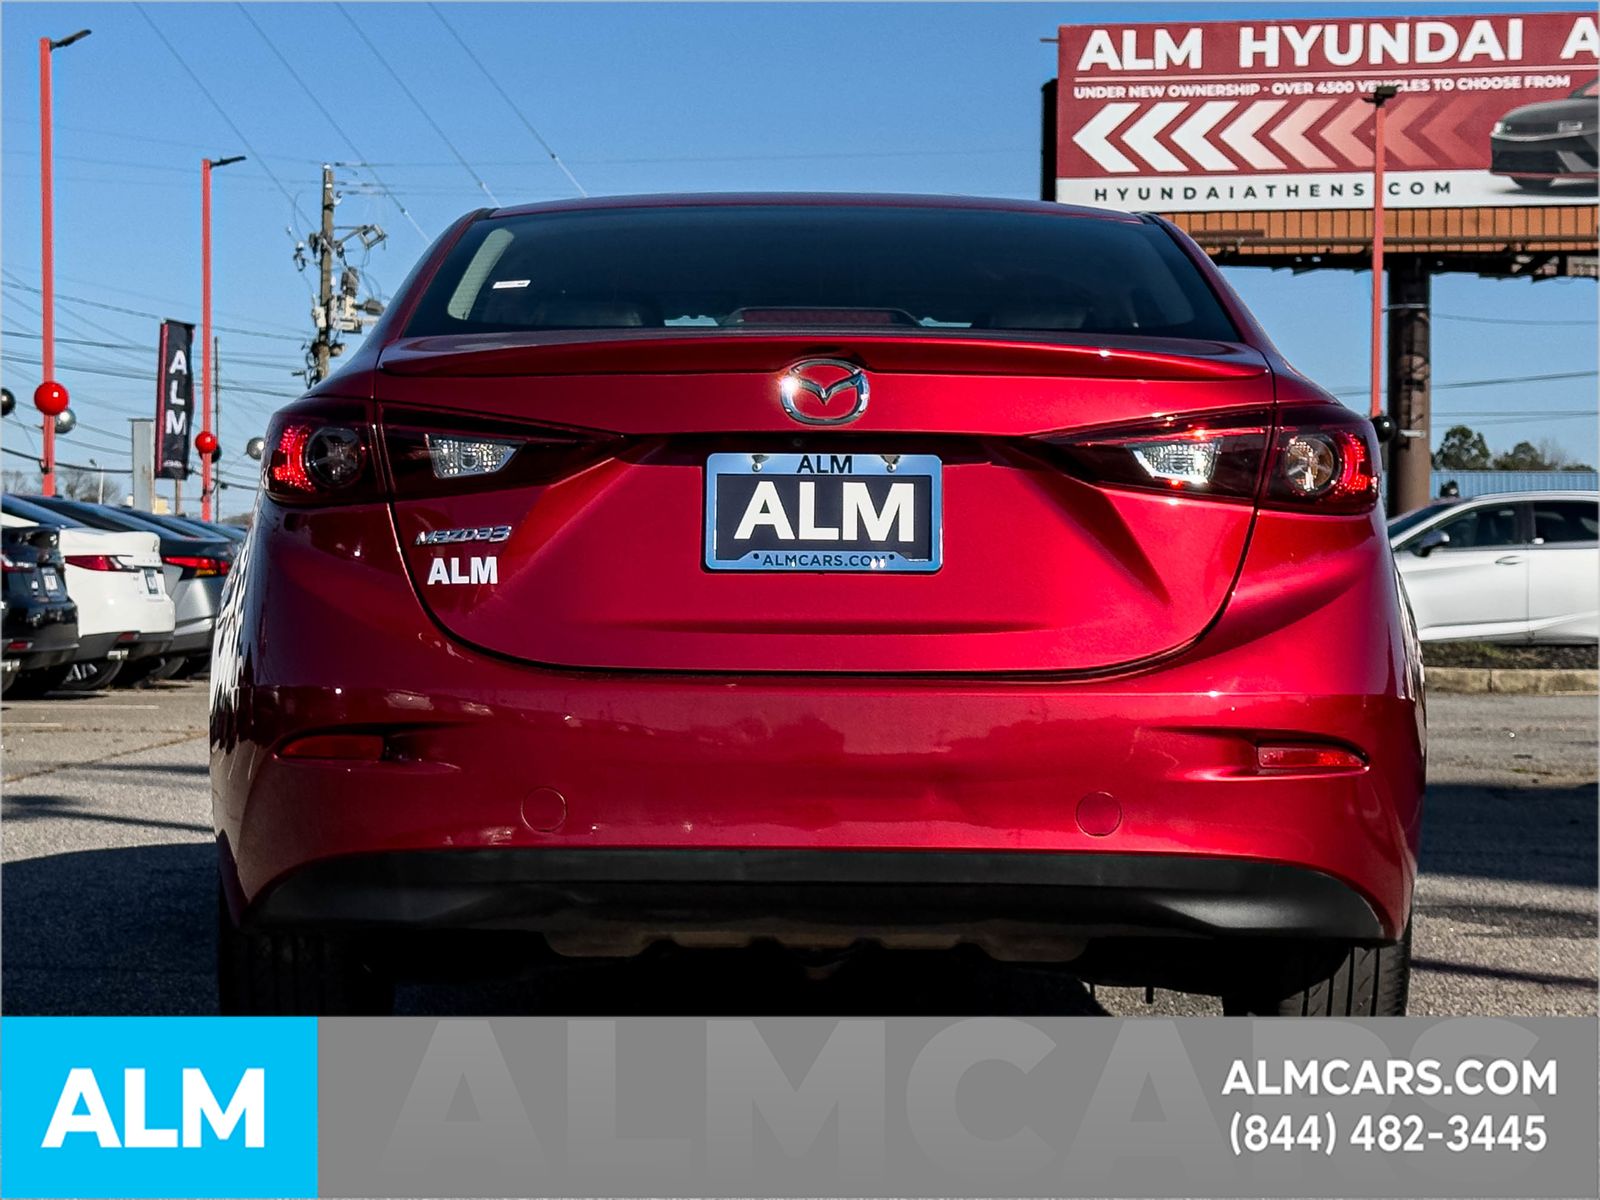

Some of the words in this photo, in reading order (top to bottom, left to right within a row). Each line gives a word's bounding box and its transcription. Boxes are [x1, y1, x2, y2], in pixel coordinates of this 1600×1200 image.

[1077, 28, 1202, 71] ALM
[1239, 19, 1523, 67] HYUNDAI
[1074, 85, 1126, 99] UNDER
[1128, 85, 1166, 98] NEW
[1167, 83, 1260, 97] OWNERSHIP
[1271, 82, 1314, 96] OVER
[1315, 81, 1354, 94] 4500
[1432, 78, 1455, 91] TO
[1456, 76, 1522, 90] CHOOSE
[1524, 75, 1571, 89] FROM
[1094, 181, 1452, 201] HYUNDAIATHENSCOM
[165, 350, 188, 435] ALM
[797, 455, 853, 473] ALM
[734, 481, 914, 541] ALM
[427, 556, 498, 585] ALM
[763, 554, 886, 568] ALMCARS.COM
